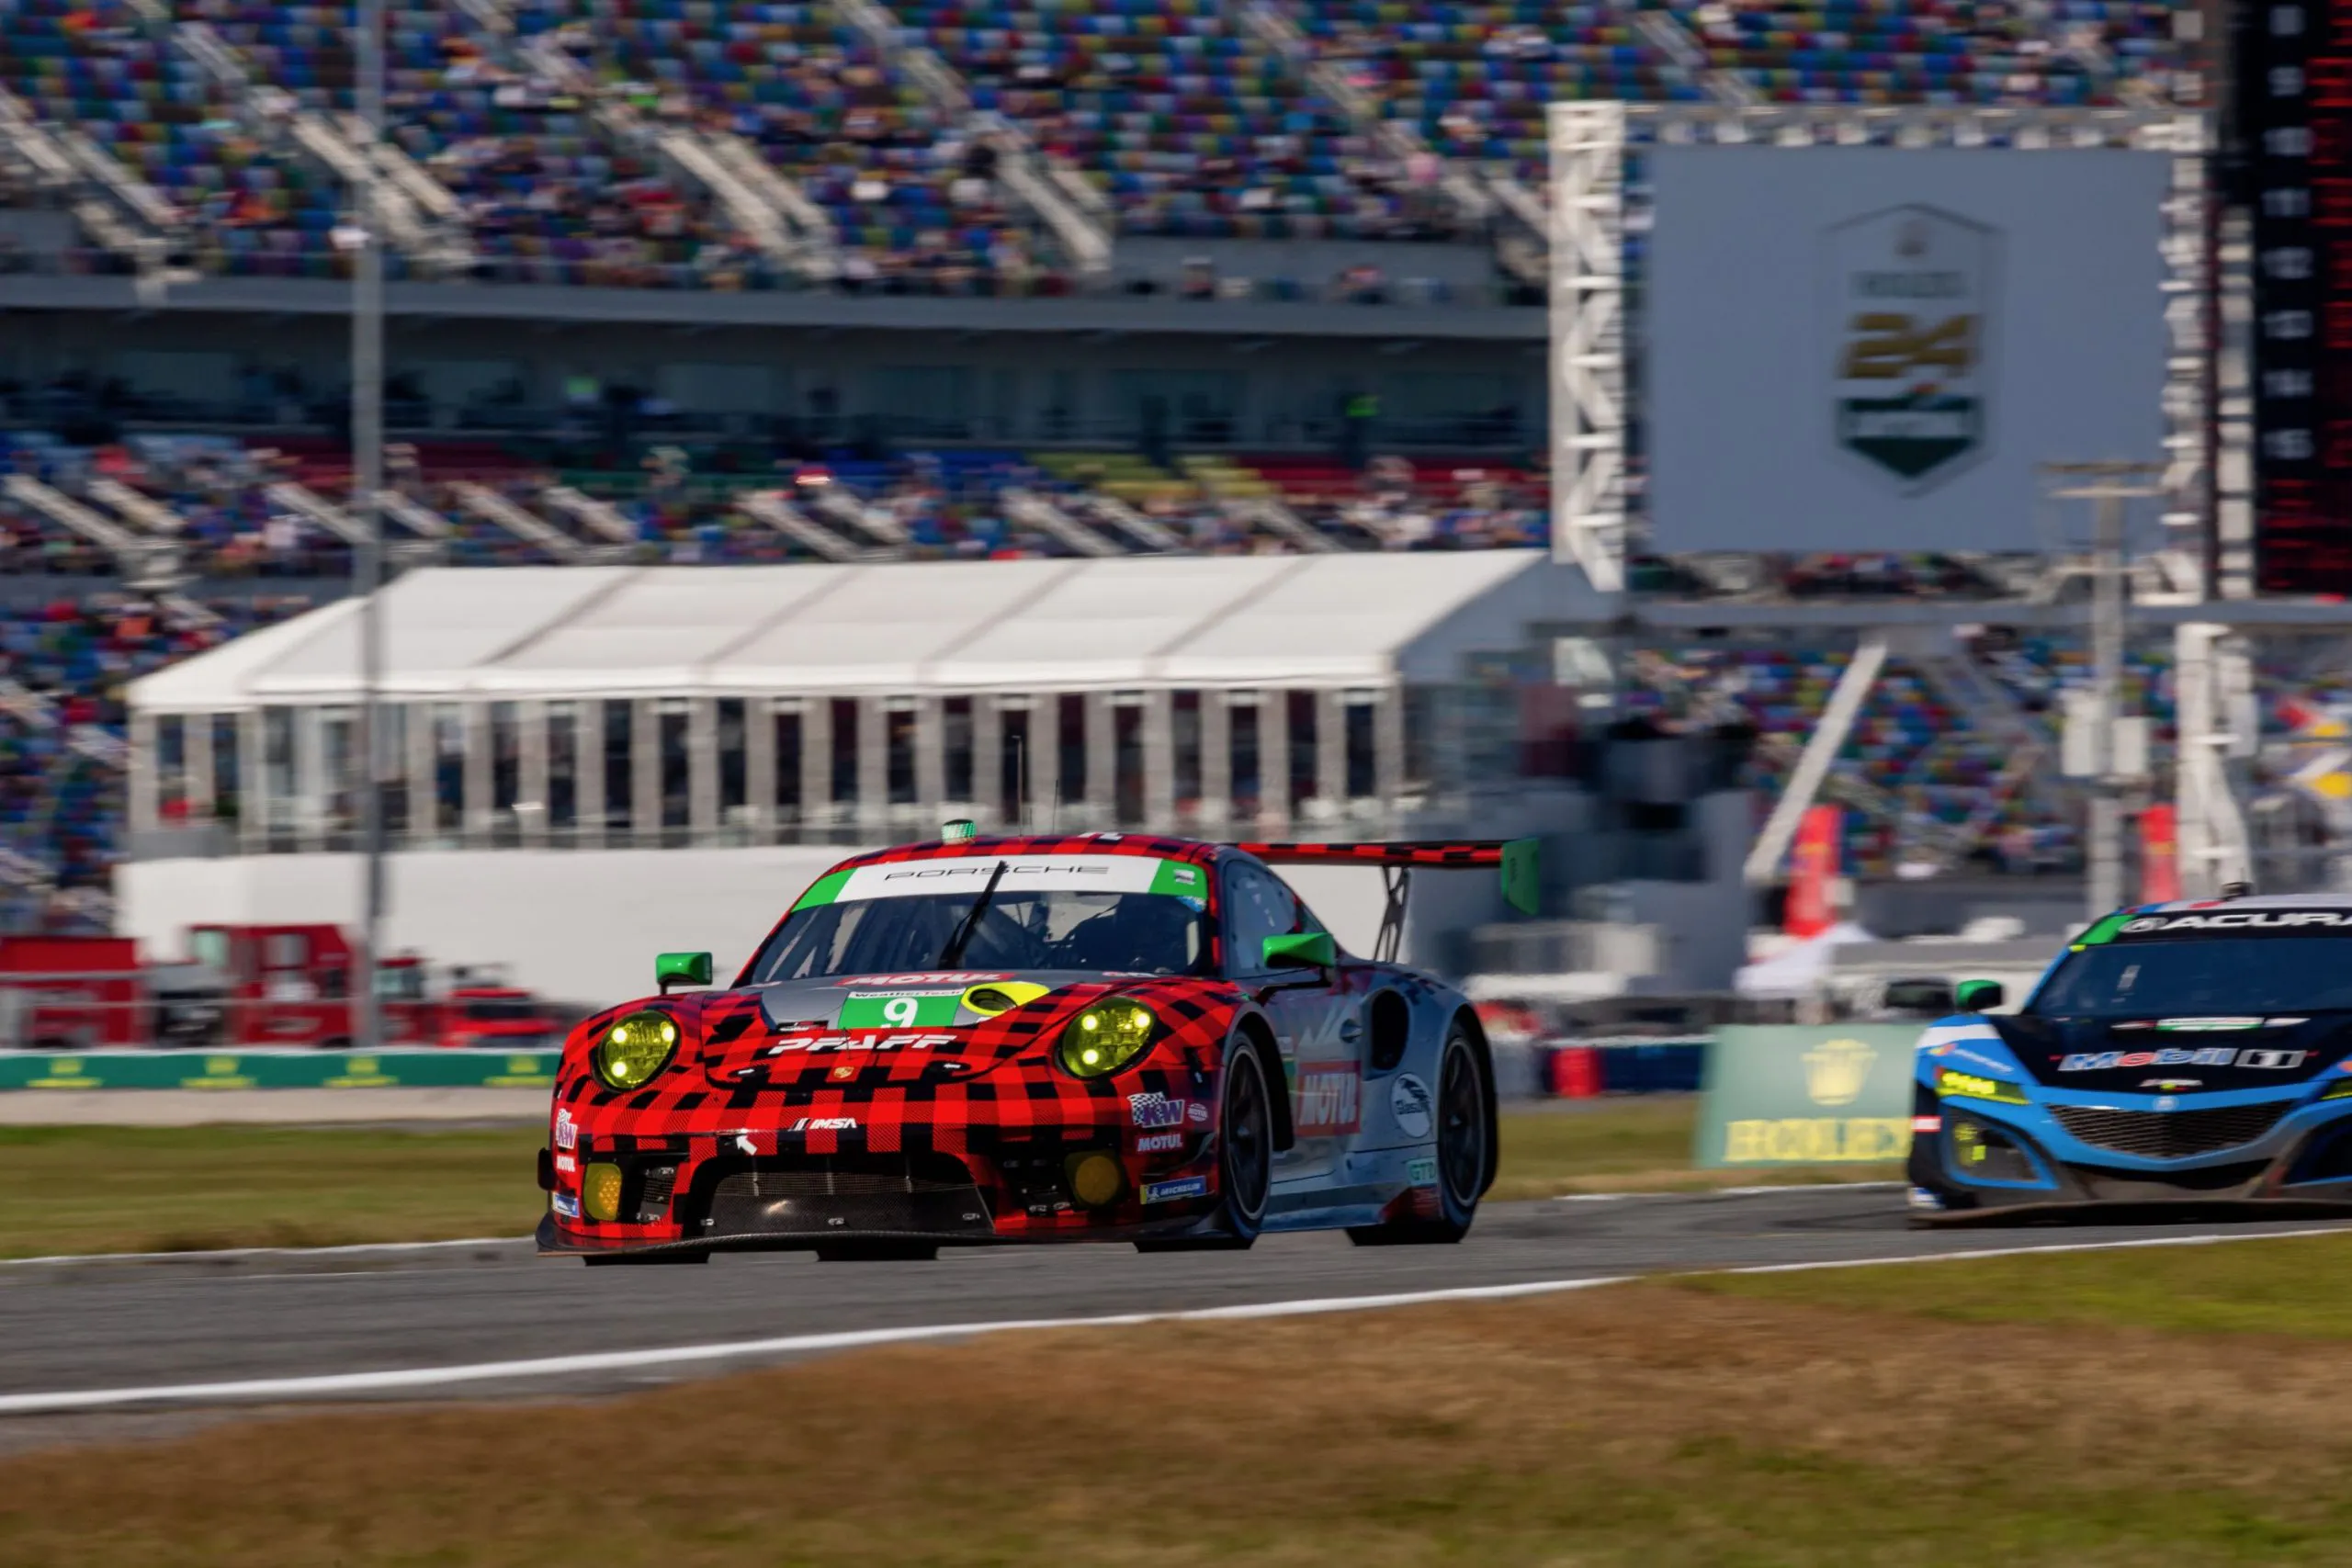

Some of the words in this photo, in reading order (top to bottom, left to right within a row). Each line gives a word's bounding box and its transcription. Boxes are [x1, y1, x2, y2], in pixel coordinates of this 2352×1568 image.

[884, 863, 1109, 881] PORSCHE
[2161, 913, 2352, 930] ACUR
[844, 973, 1002, 986] MOTUL
[880, 998, 918, 1028] 9
[1141, 1100, 1183, 1126] KW
[809, 1117, 857, 1130] IMSA
[1137, 1134, 1182, 1152] MOTUL
